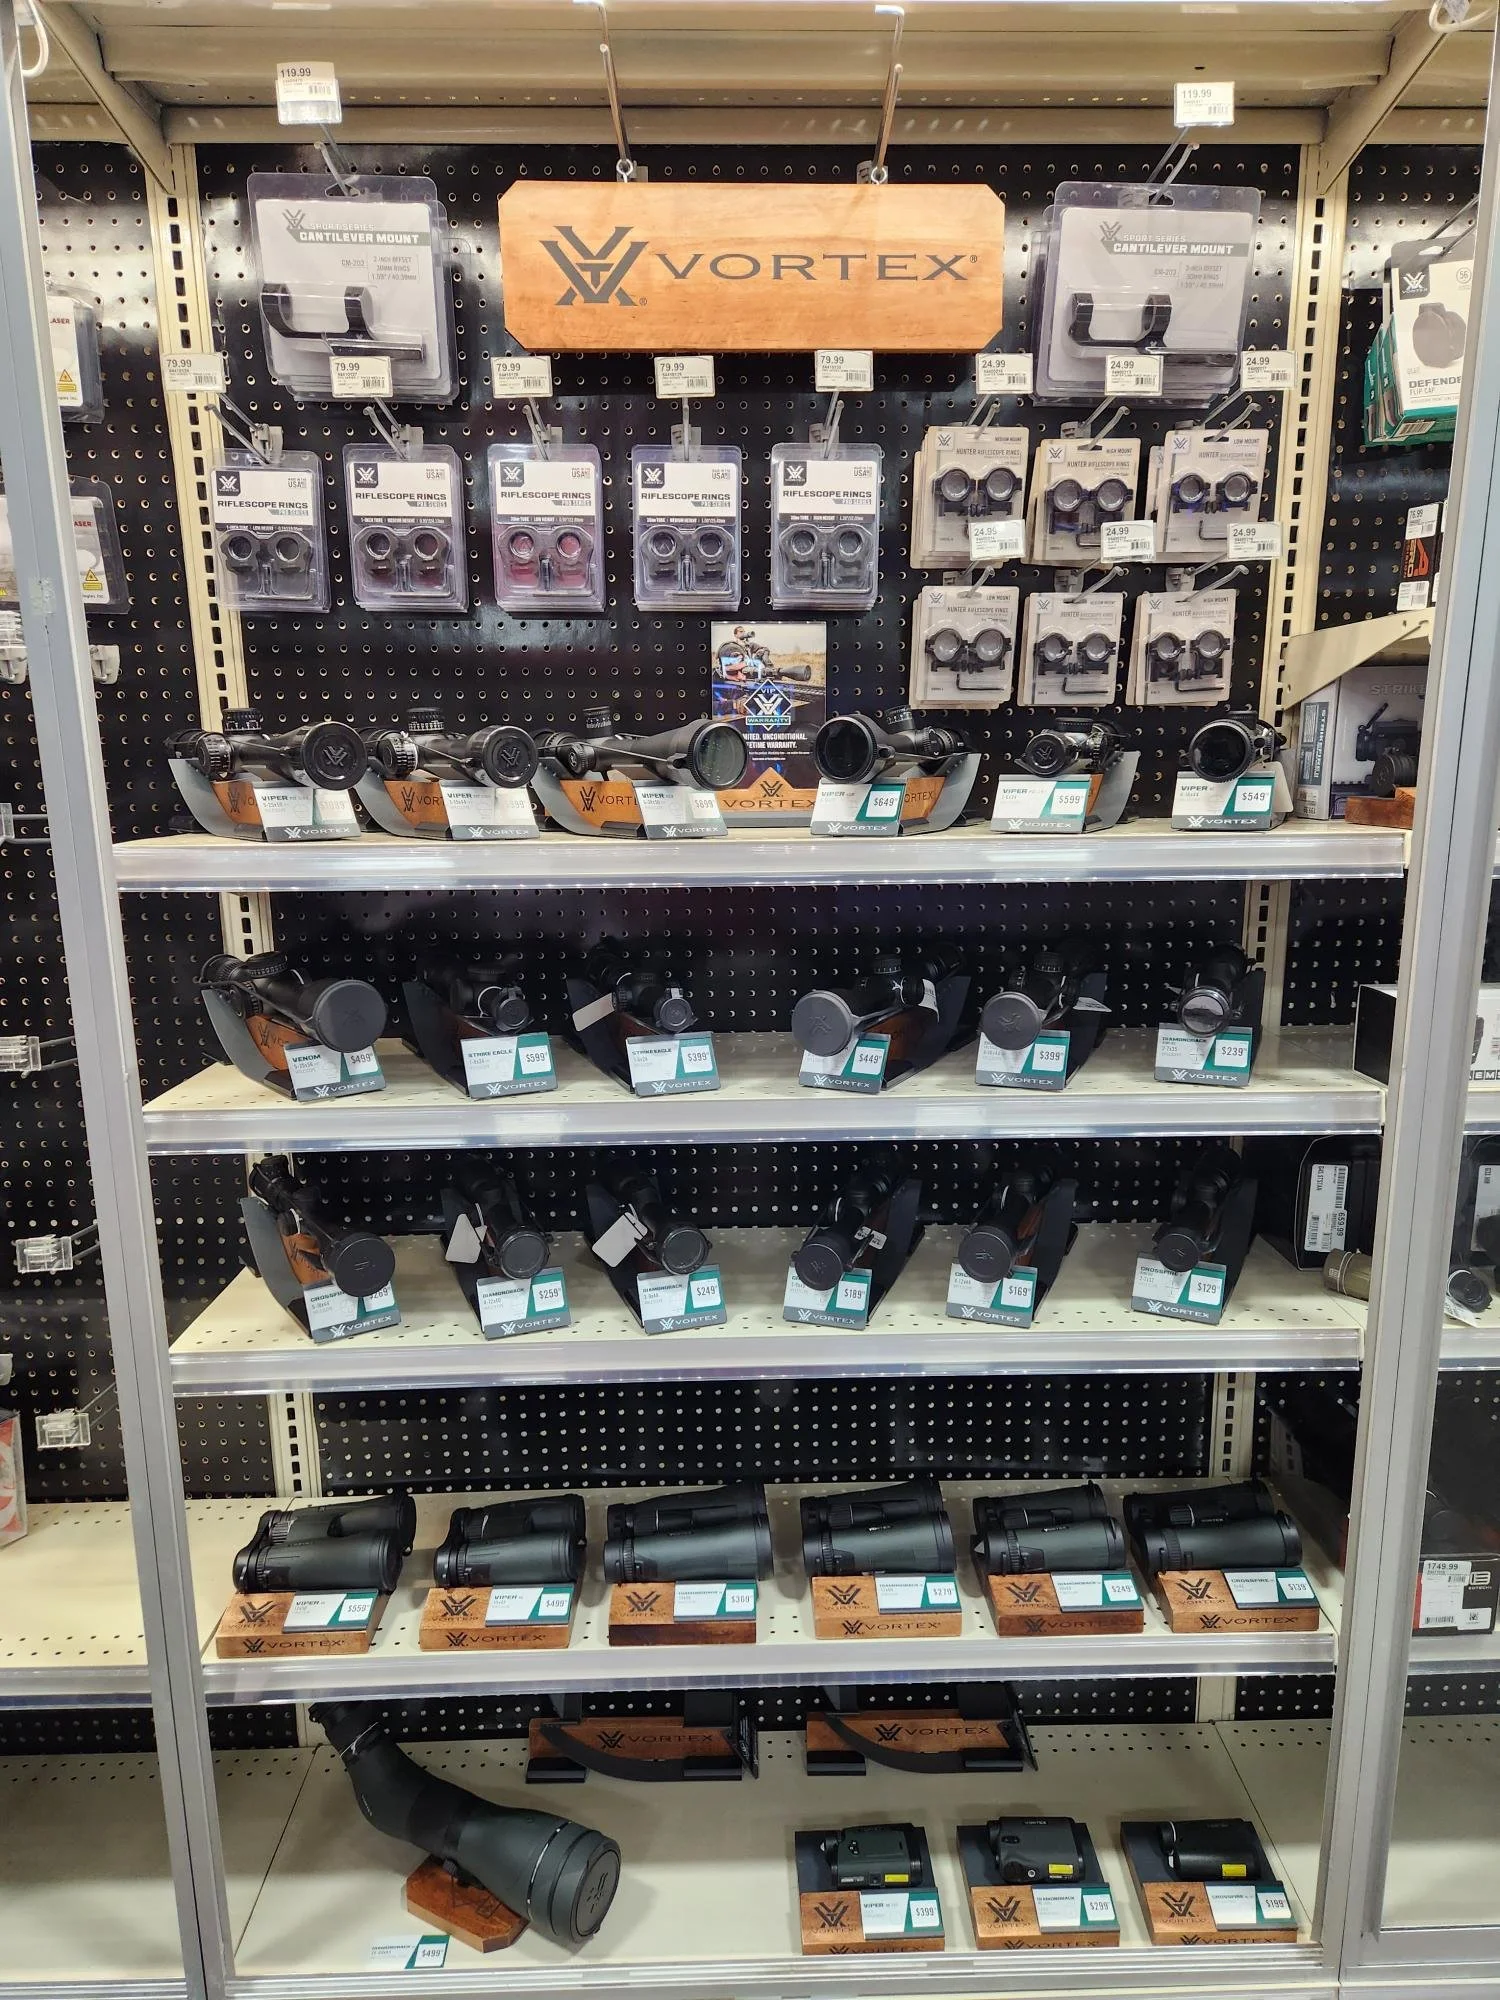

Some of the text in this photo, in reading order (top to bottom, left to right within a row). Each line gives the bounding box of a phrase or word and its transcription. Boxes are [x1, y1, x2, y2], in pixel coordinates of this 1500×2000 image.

[281, 67, 311, 78] 119.99
[1182, 89, 1212, 99] 119.99
[299, 231, 419, 245] CANTILEVER MOUNT
[1113, 243, 1233, 255] CANTILEVER MOUNT
[167, 359, 192, 368] 79.99
[820, 356, 844, 365] 79.99
[982, 360, 1006, 368] 24.99
[1110, 361, 1135, 369] 24.99
[1246, 357, 1270, 366] 24.99
[335, 363, 360, 371] 79.99
[496, 363, 521, 372] 79.99
[660, 363, 685, 372] 79.99
[1408, 376, 1461, 389] DEFENDE
[355, 492, 447, 501] RIFLESCOPE RINGS
[501, 491, 592, 500] RIFLESCOPE RINGS
[641, 492, 731, 501] RIFLESCOPE RINGS
[783, 490, 841, 498] RIFLESCOPE
[217, 500, 309, 509] RIFLESCOPE RINGS
[974, 527, 997, 536] 24.99
[1106, 526, 1129, 536] 24.99
[1233, 528, 1256, 537] 24.99
[766, 741, 797, 749] WARRANTY.
[904, 791, 934, 803] ORTEX
[1059, 795, 1081, 804] $599
[1241, 792, 1265, 801] $549
[723, 799, 815, 809] VORTEX
[873, 798, 895, 807] $649
[302, 826, 351, 834] VORTEX
[1040, 1051, 1060, 1061] $399
[1221, 1046, 1243, 1057] $239
[292, 1054, 321, 1063] VENOM
[350, 1053, 371, 1064] $499
[525, 1052, 545, 1063] $599
[687, 1052, 707, 1062] $399
[858, 1053, 879, 1064] $449
[1006, 1077, 1054, 1085] VORTEX
[1188, 1073, 1238, 1081] VORTEX
[330, 1080, 376, 1093] VORTEX
[502, 1080, 548, 1090] VORTEX
[668, 1080, 712, 1088] VORTEX
[828, 1078, 870, 1088] VORTEX
[1336, 1212, 1346, 1237] 659.99
[696, 1286, 715, 1296] $249
[1008, 1285, 1028, 1296] $169
[1197, 1282, 1217, 1294] $129
[538, 1289, 559, 1299] $259
[844, 1288, 862, 1299] $189
[976, 1311, 1021, 1322] VORTEX
[1162, 1305, 1210, 1319] VORTEX
[346, 1315, 392, 1330] VORTEX
[516, 1317, 561, 1329] VORTEX
[674, 1314, 718, 1325] VORTEX
[812, 1313, 856, 1325] VORTEX
[1427, 1562, 1459, 1570] 1749.99
[1222, 1616, 1294, 1625] VORTEX
[865, 1623, 935, 1631] VORTEX
[470, 1634, 543, 1643] VORTEX
[267, 1640, 342, 1649] VORTEX
[904, 1726, 992, 1736] VORTEX
[627, 1734, 714, 1744] VORTEX
[1089, 1901, 1109, 1911] $299
[1265, 1899, 1284, 1908] $199
[915, 1906, 934, 1916] $399
[421, 1949, 441, 1958] $499
